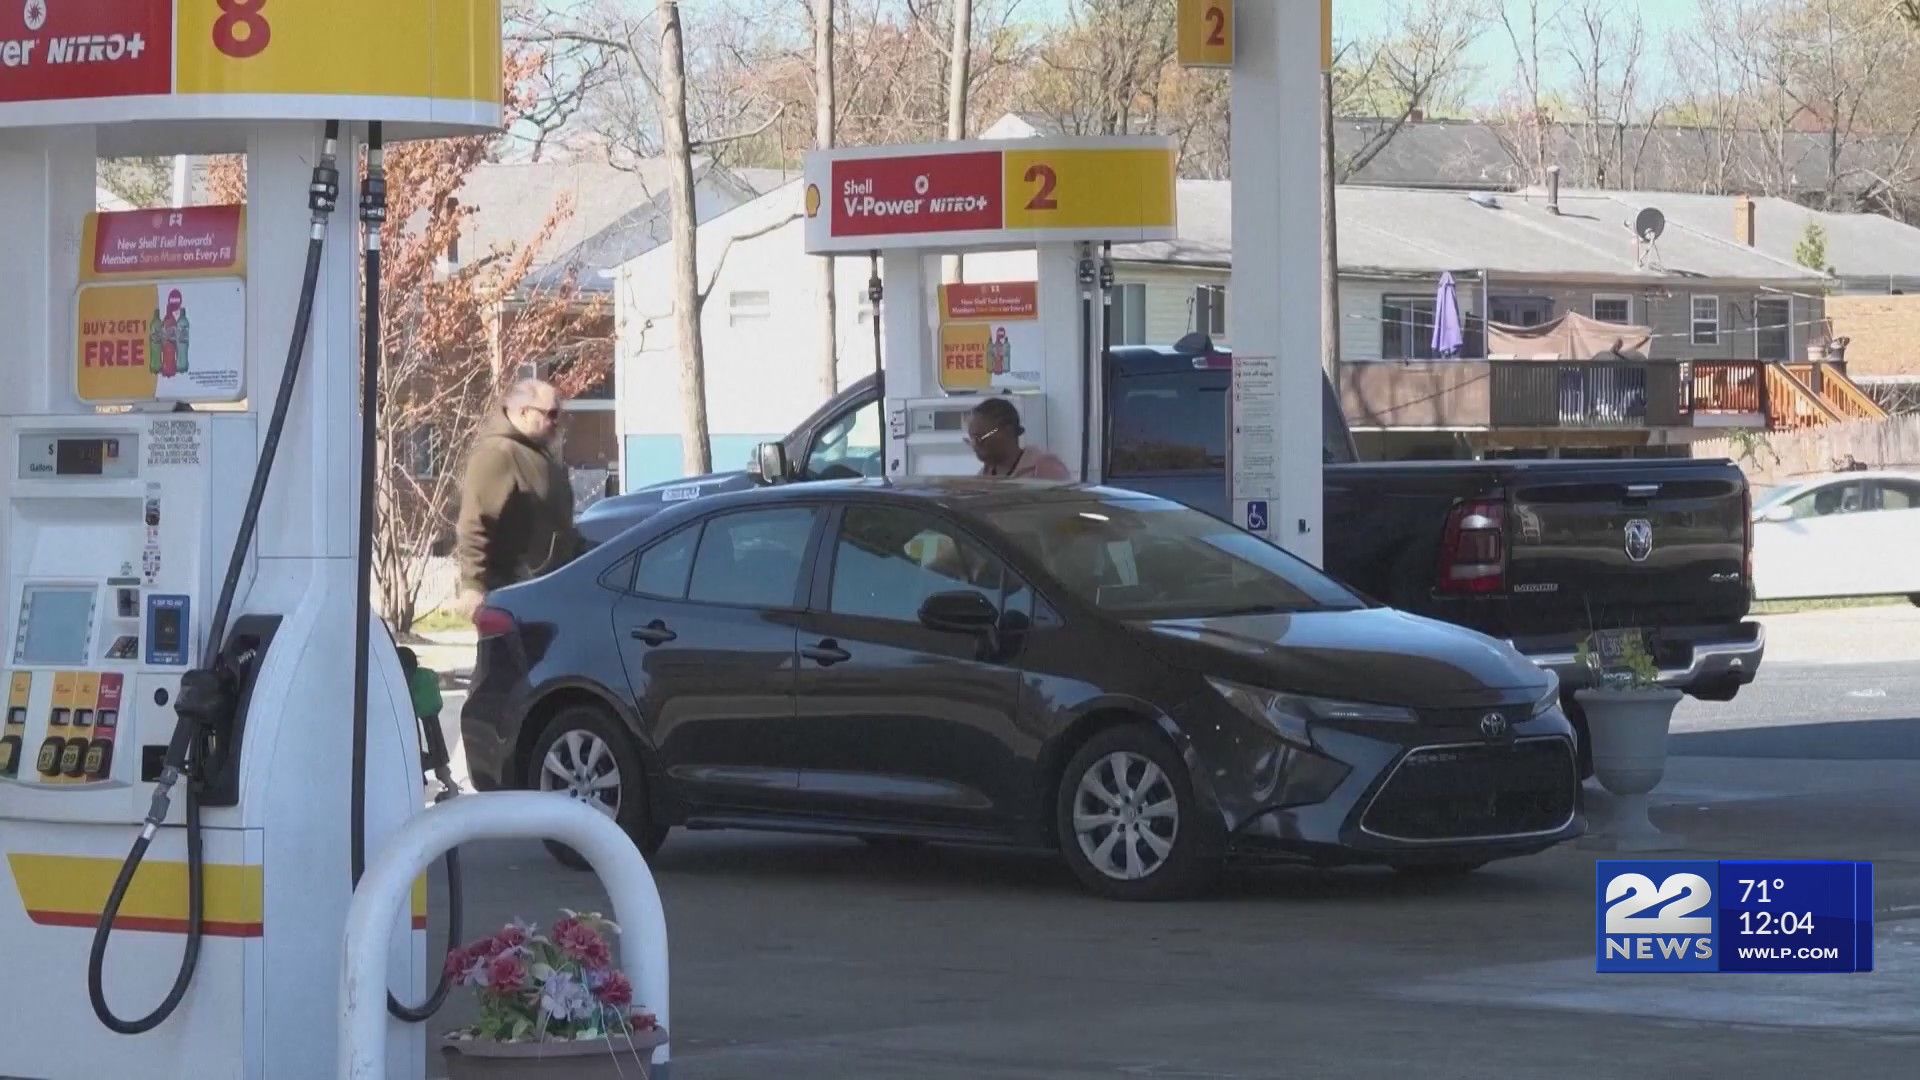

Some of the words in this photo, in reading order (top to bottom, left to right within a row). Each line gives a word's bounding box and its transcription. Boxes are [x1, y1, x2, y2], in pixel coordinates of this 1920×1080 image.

[1205, 6, 1225, 46] 2
[843, 179, 873, 196] Shell
[1023, 163, 1058, 210] 2
[843, 197, 923, 217] V-Power
[117, 238, 136, 250] New
[160, 235, 176, 248] Fuel
[177, 234, 212, 247] Rewards
[101, 253, 138, 265] Members
[183, 252, 194, 261] on
[195, 249, 219, 263] Every
[219, 247, 231, 260] Fill
[83, 321, 107, 336] BUY
[109, 321, 116, 335] 2
[118, 320, 140, 334] GET
[141, 319, 147, 333] 1
[84, 339, 145, 368] FREE
[944, 343, 960, 352] BUY
[967, 343, 980, 352] GET
[945, 353, 984, 370] FREE
[30, 462, 54, 473] Gallons
